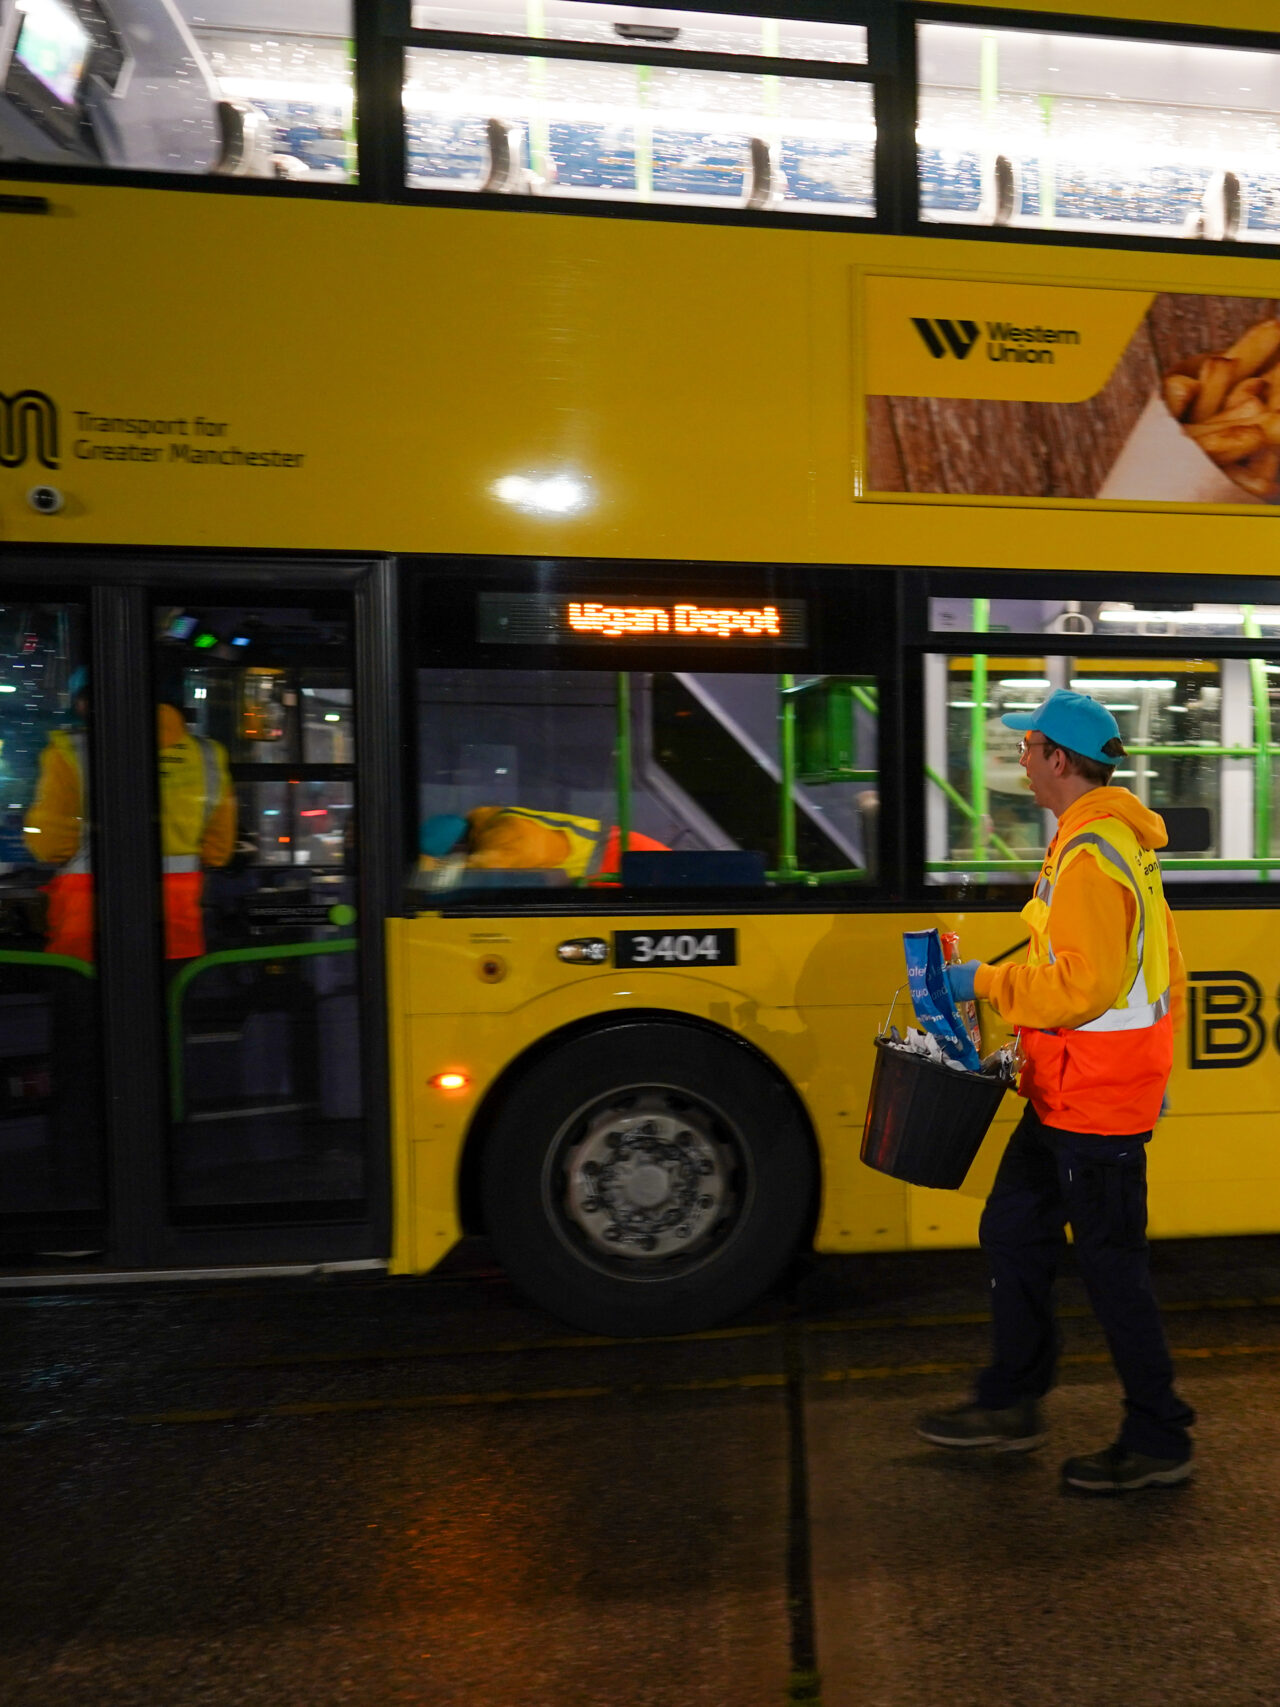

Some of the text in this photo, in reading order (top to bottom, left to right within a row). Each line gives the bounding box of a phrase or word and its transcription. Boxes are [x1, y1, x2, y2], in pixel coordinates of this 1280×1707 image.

[985, 321, 1080, 345] Western
[987, 342, 1055, 364] Union
[72, 411, 230, 439] Transport for
[72, 439, 306, 468] Greater Manchester
[568, 602, 780, 638] Wigan Depot
[631, 934, 721, 962] 3404
